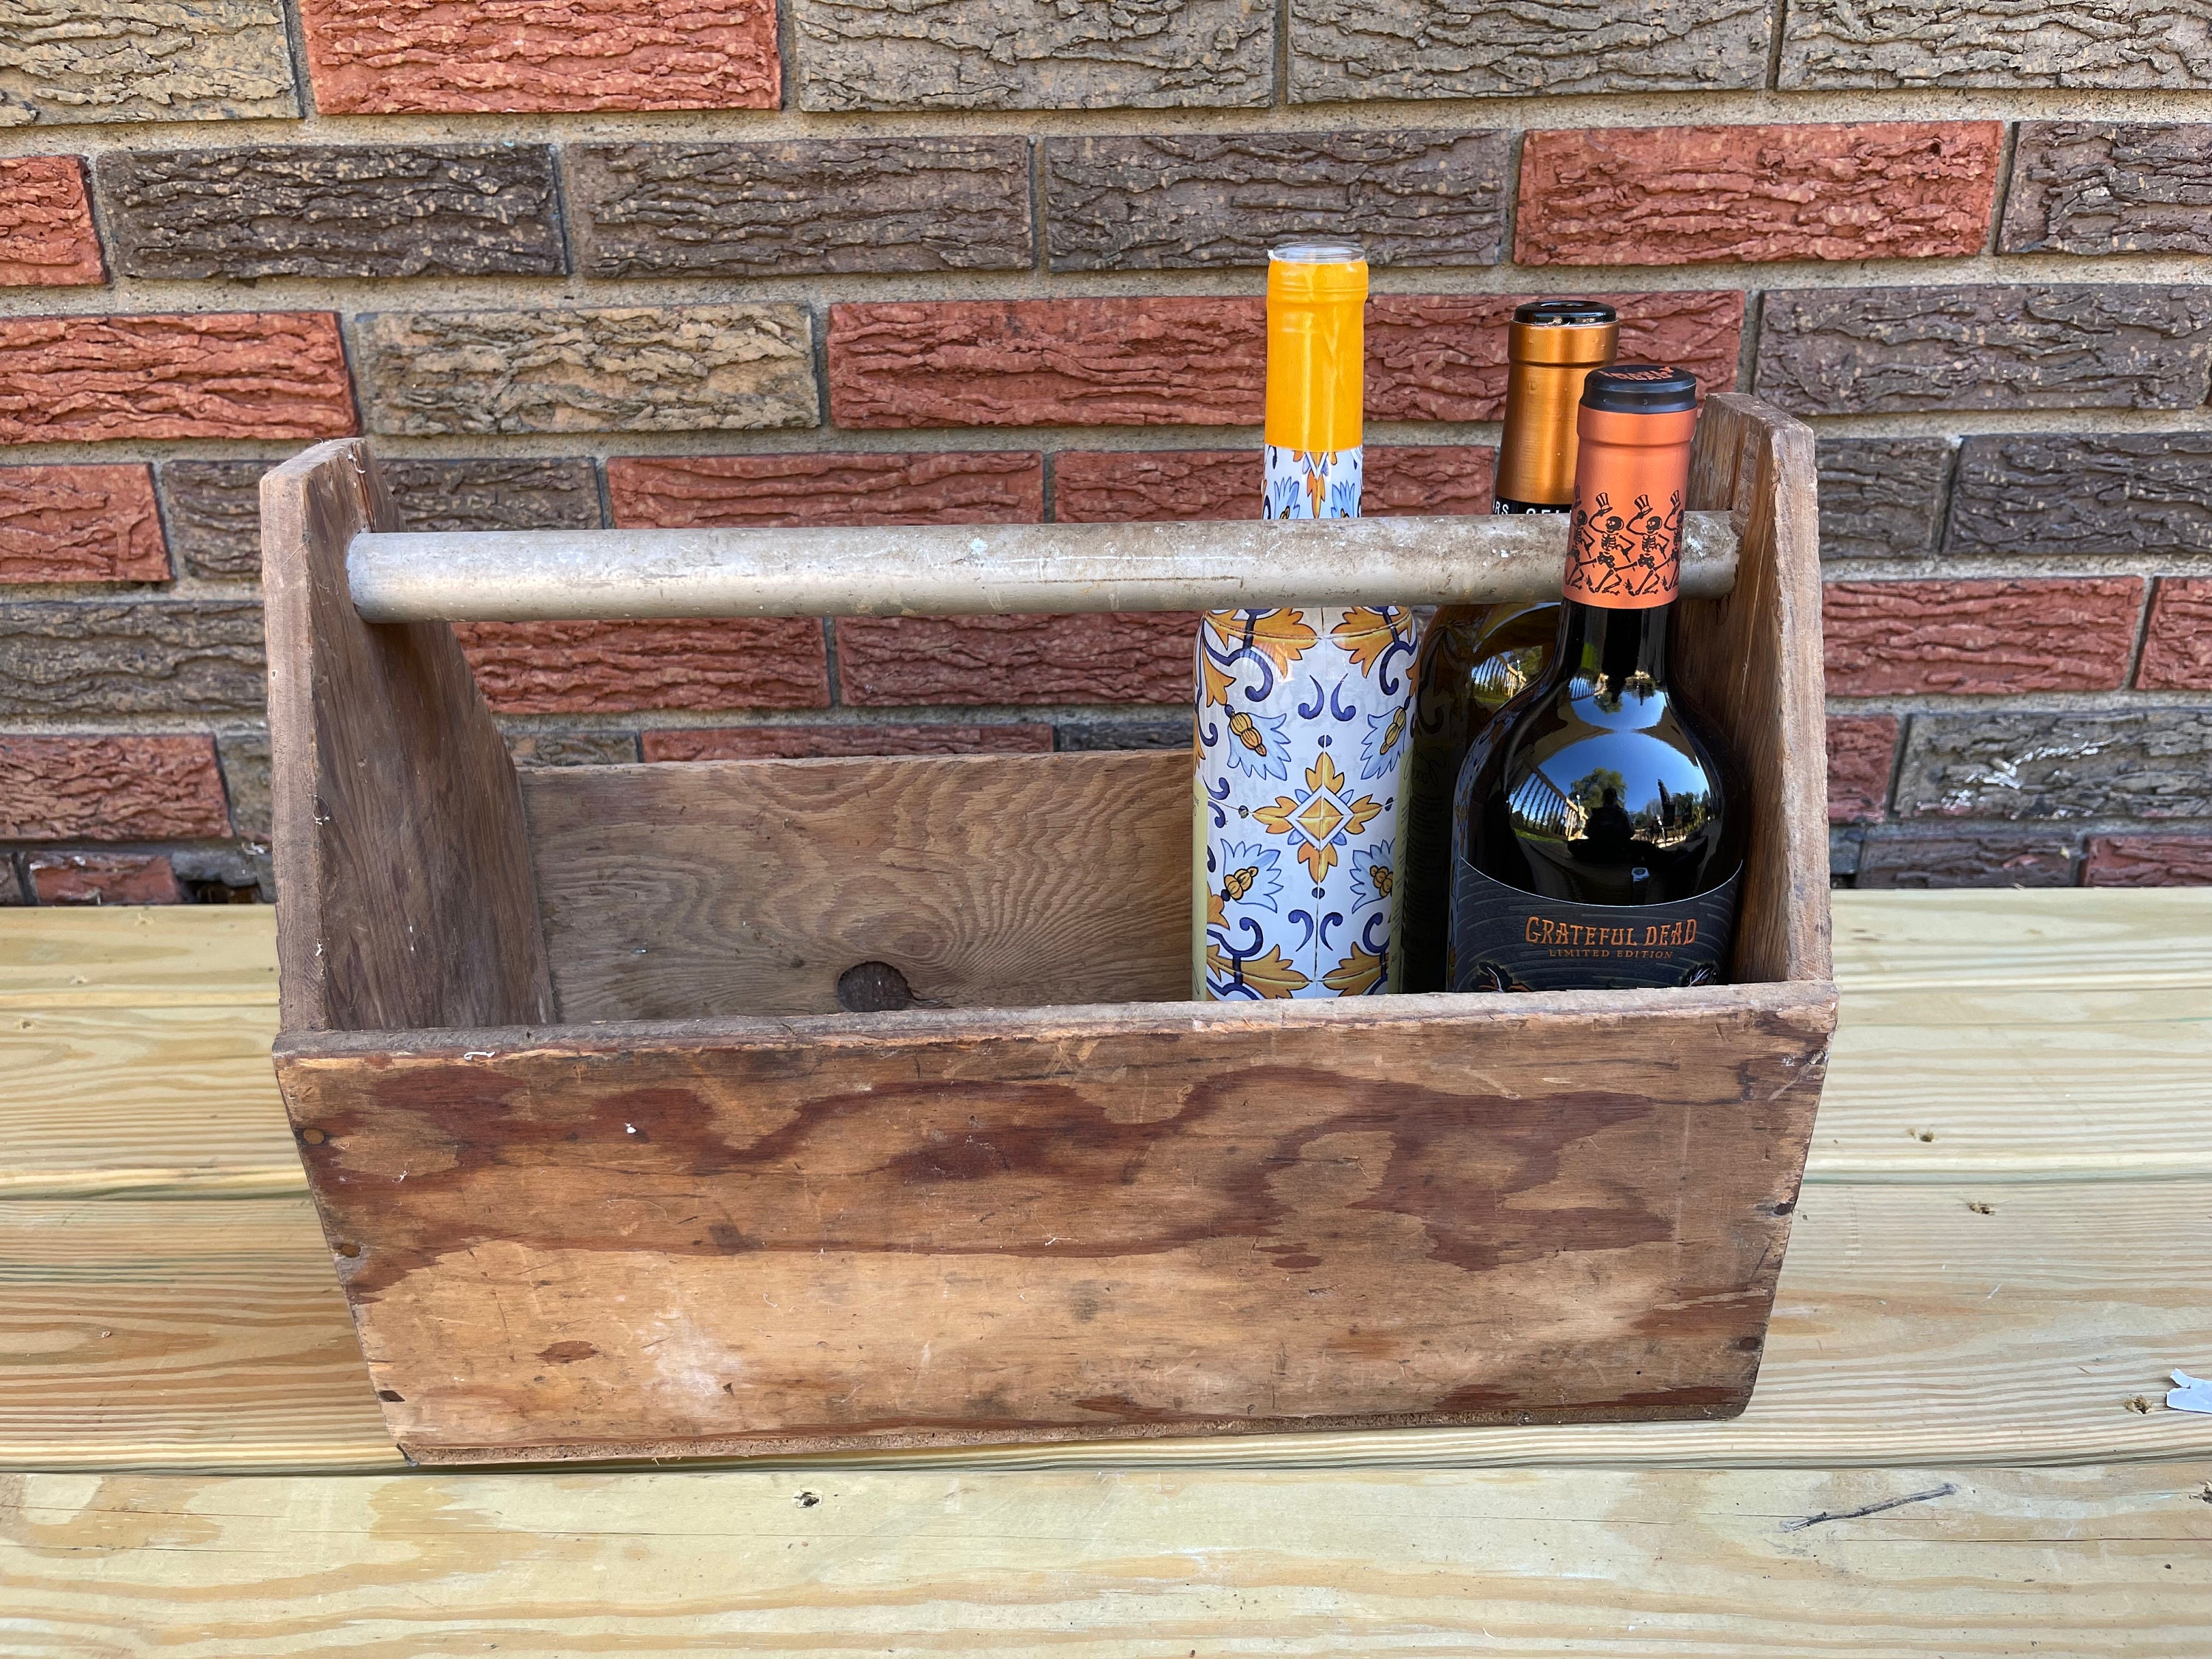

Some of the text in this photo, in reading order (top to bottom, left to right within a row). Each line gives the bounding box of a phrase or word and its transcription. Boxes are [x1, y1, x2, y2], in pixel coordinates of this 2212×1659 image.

[1526, 917, 1697, 946] GRATEFUL DEAD
[1548, 949, 1673, 959] LIMITED EDITION
